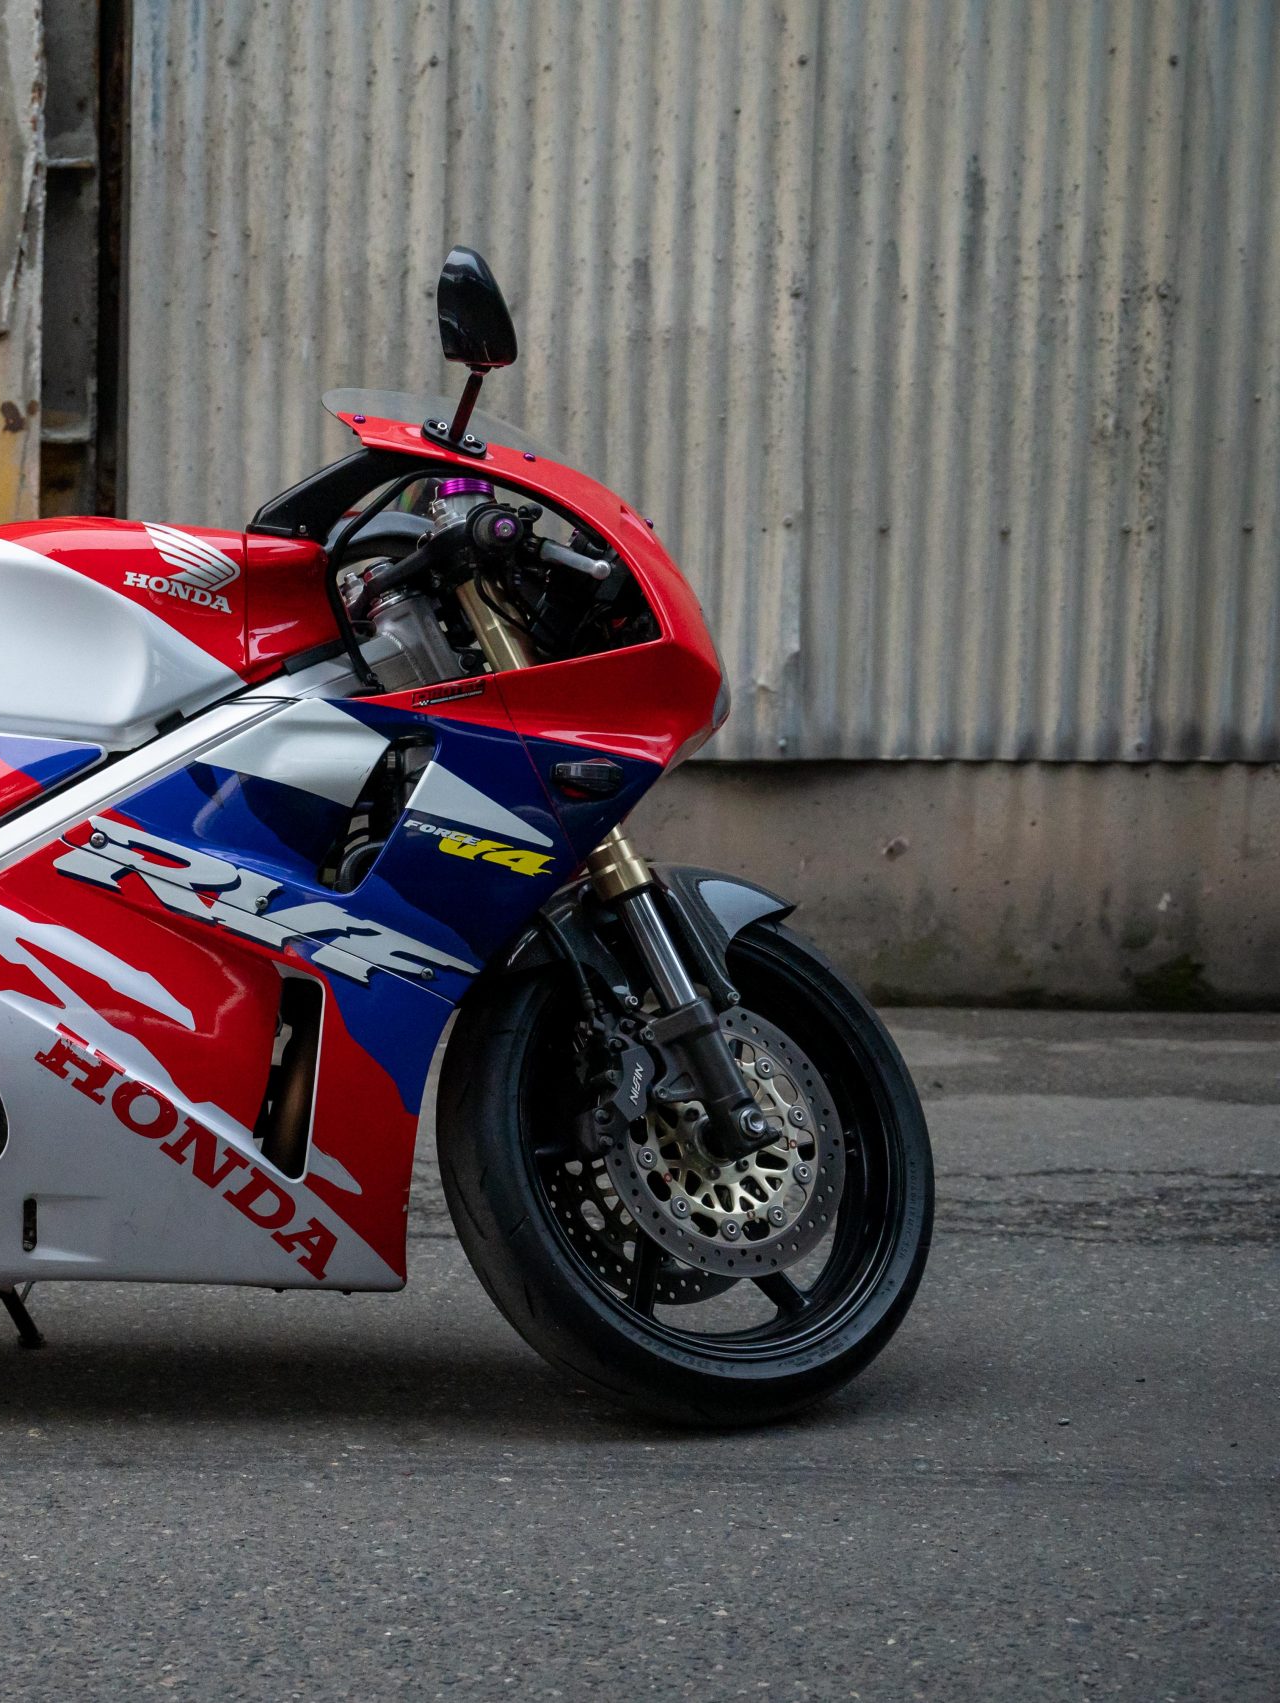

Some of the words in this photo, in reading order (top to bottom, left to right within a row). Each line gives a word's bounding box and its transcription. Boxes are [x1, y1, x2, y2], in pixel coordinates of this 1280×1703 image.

[123, 571, 232, 614] HONDA
[403, 819, 482, 846] FORCE
[438, 830, 557, 877] V4
[53, 816, 480, 983] RVF
[34, 1023, 338, 1281] HONDA
